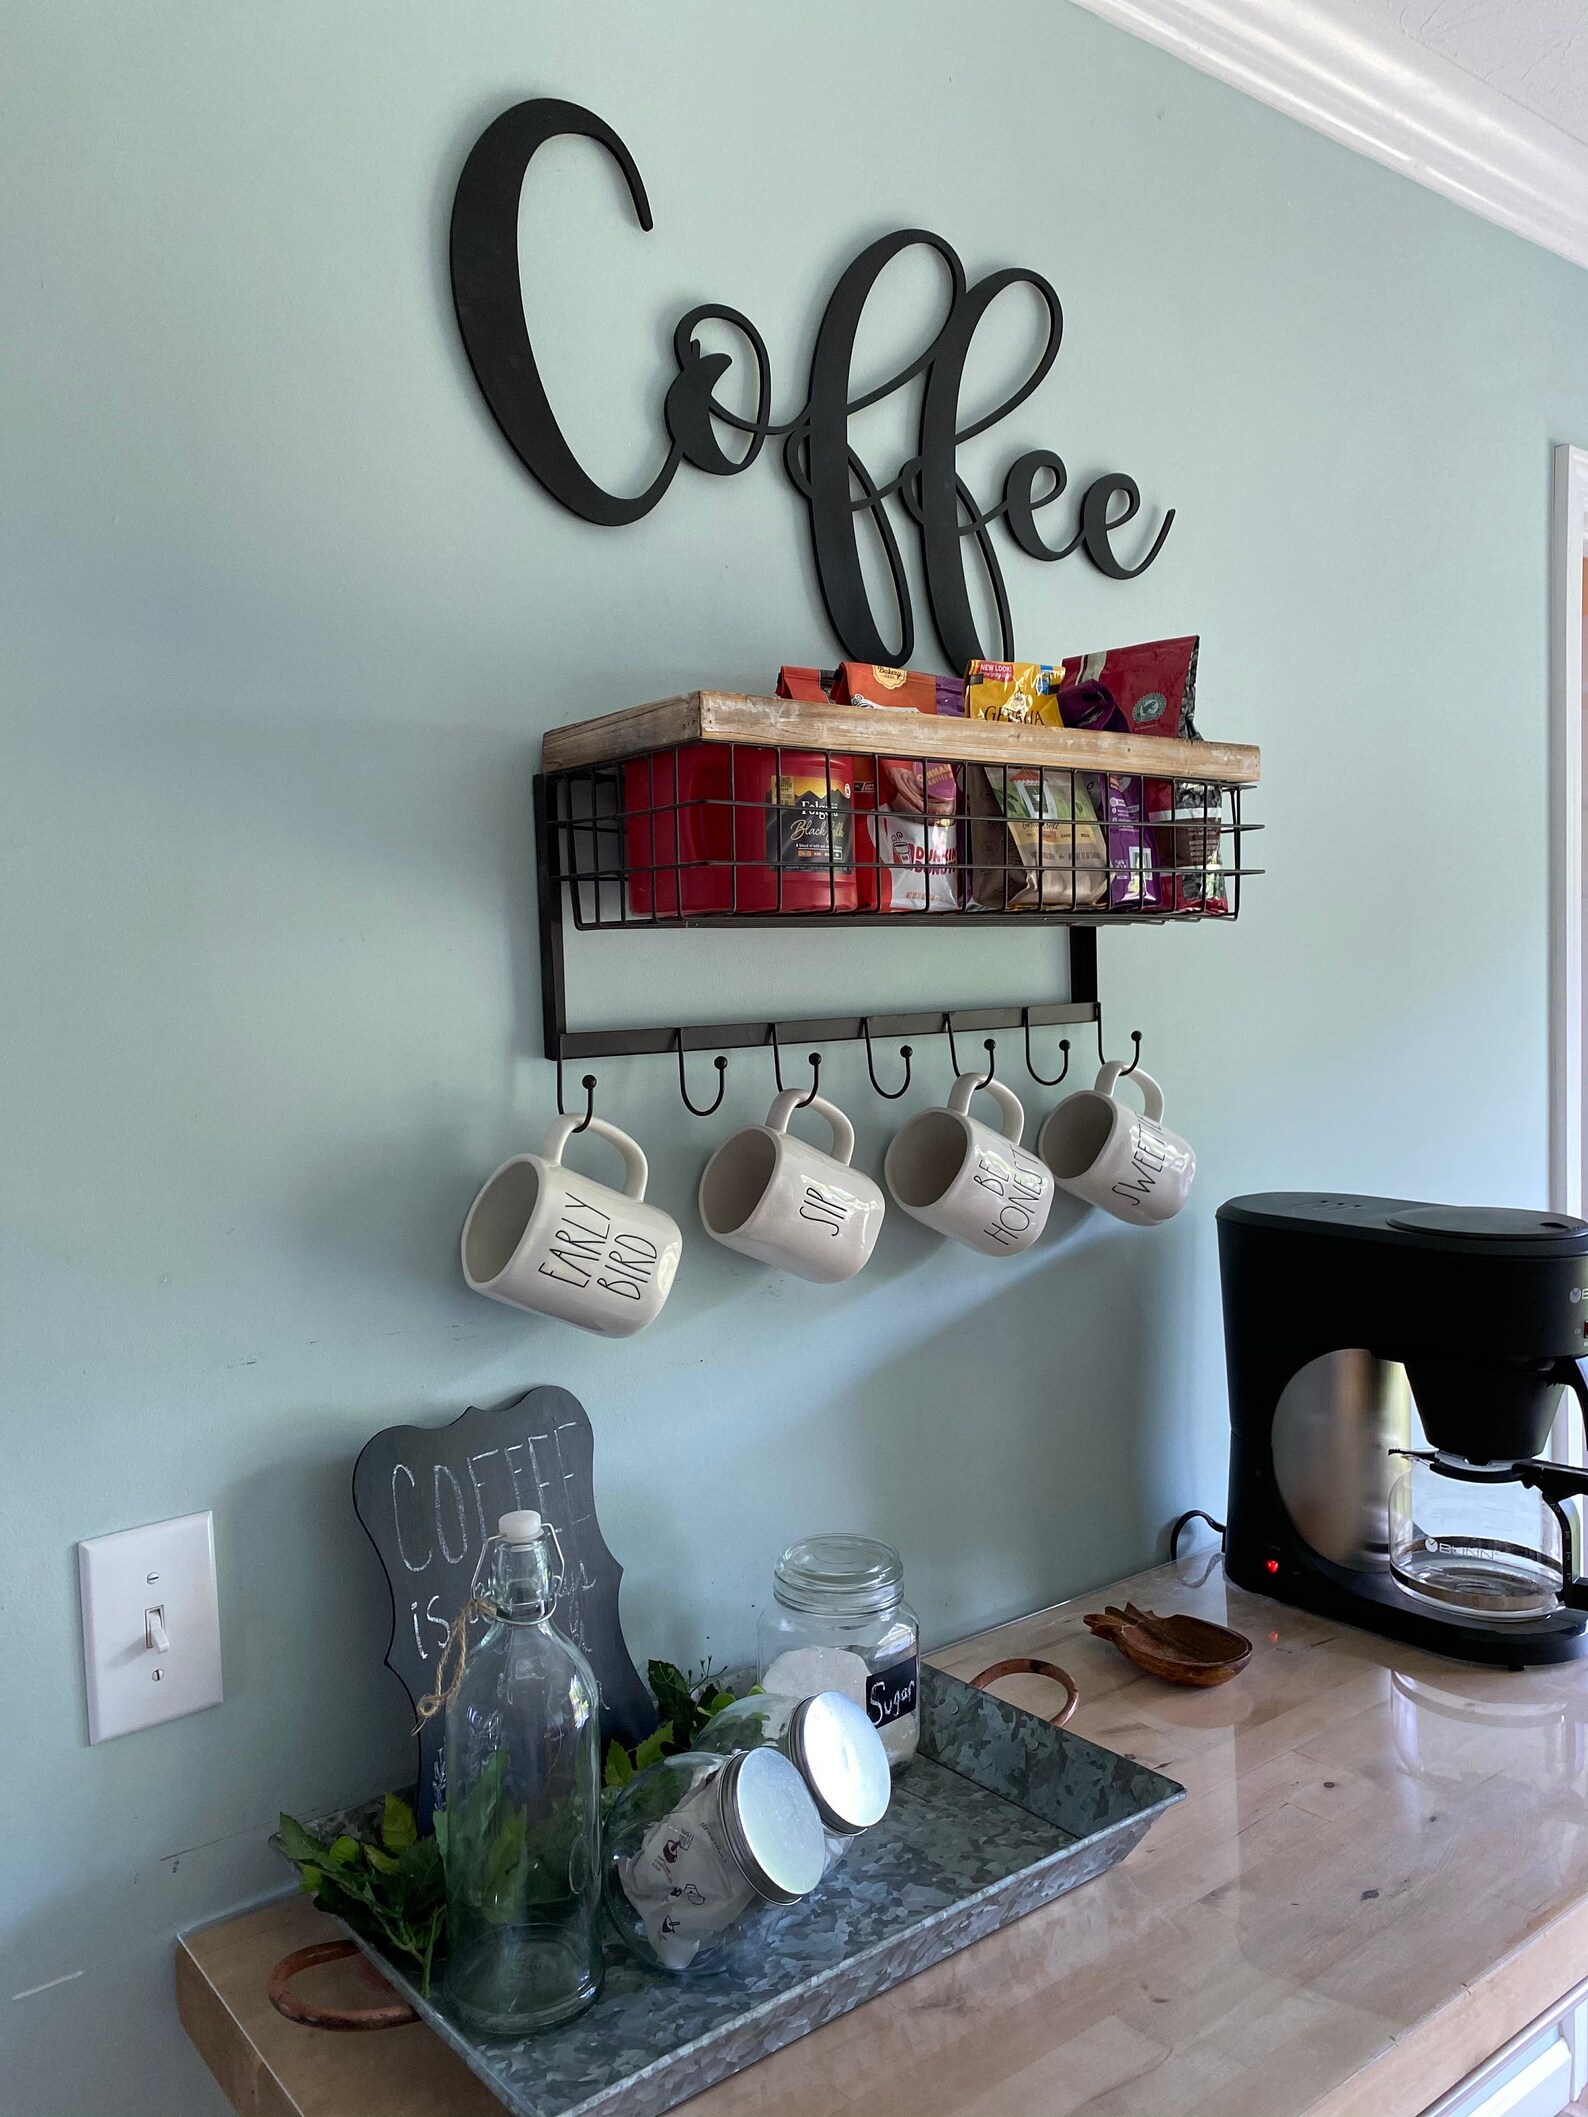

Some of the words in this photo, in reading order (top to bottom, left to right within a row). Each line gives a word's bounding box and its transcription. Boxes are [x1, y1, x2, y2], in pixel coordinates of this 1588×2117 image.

[450, 97, 1176, 677] Coffee
[790, 819, 826, 840] Black
[826, 821, 844, 842] ilk
[801, 801, 839, 820] Folgs
[973, 1158, 1011, 1198] BE
[983, 1143, 1043, 1246] HONEST
[799, 1186, 848, 1238] SIP
[537, 1191, 611, 1289] EARLY
[597, 1233, 658, 1301] BIRD
[391, 1421, 591, 1573] COFFEE
[1439, 1543, 1494, 1560] BUNN
[870, 1680, 915, 1726] Sugar
